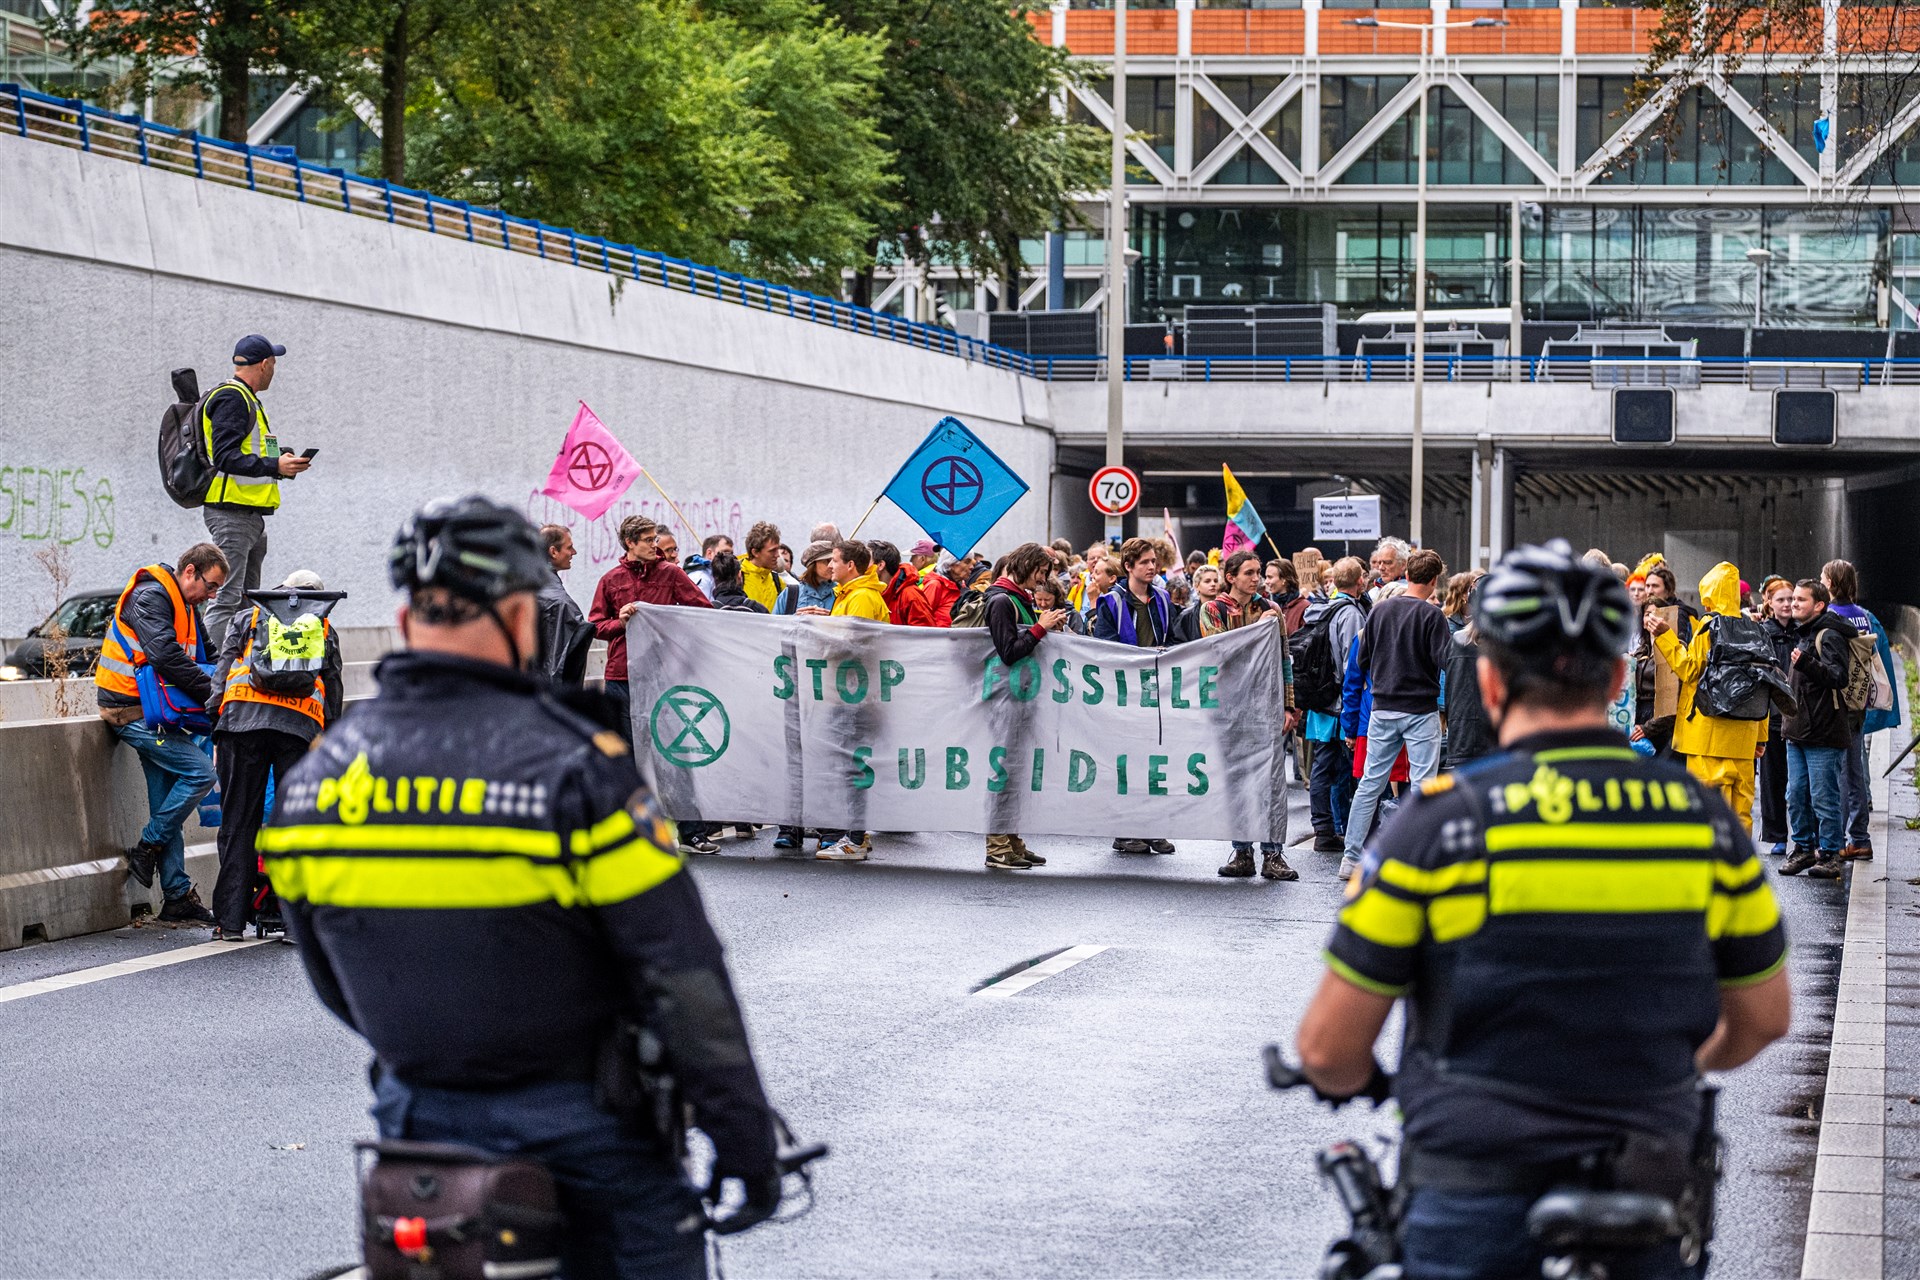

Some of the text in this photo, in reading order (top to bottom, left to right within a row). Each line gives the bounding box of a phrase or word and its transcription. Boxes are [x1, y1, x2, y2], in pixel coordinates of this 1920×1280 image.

[1100, 482, 1130, 499] 70
[773, 655, 1220, 709] STOP FOSSIELE
[316, 756, 487, 825] POLITIE
[852, 747, 1210, 796] SUBSIDIES
[1504, 766, 1690, 823] POLITIE
